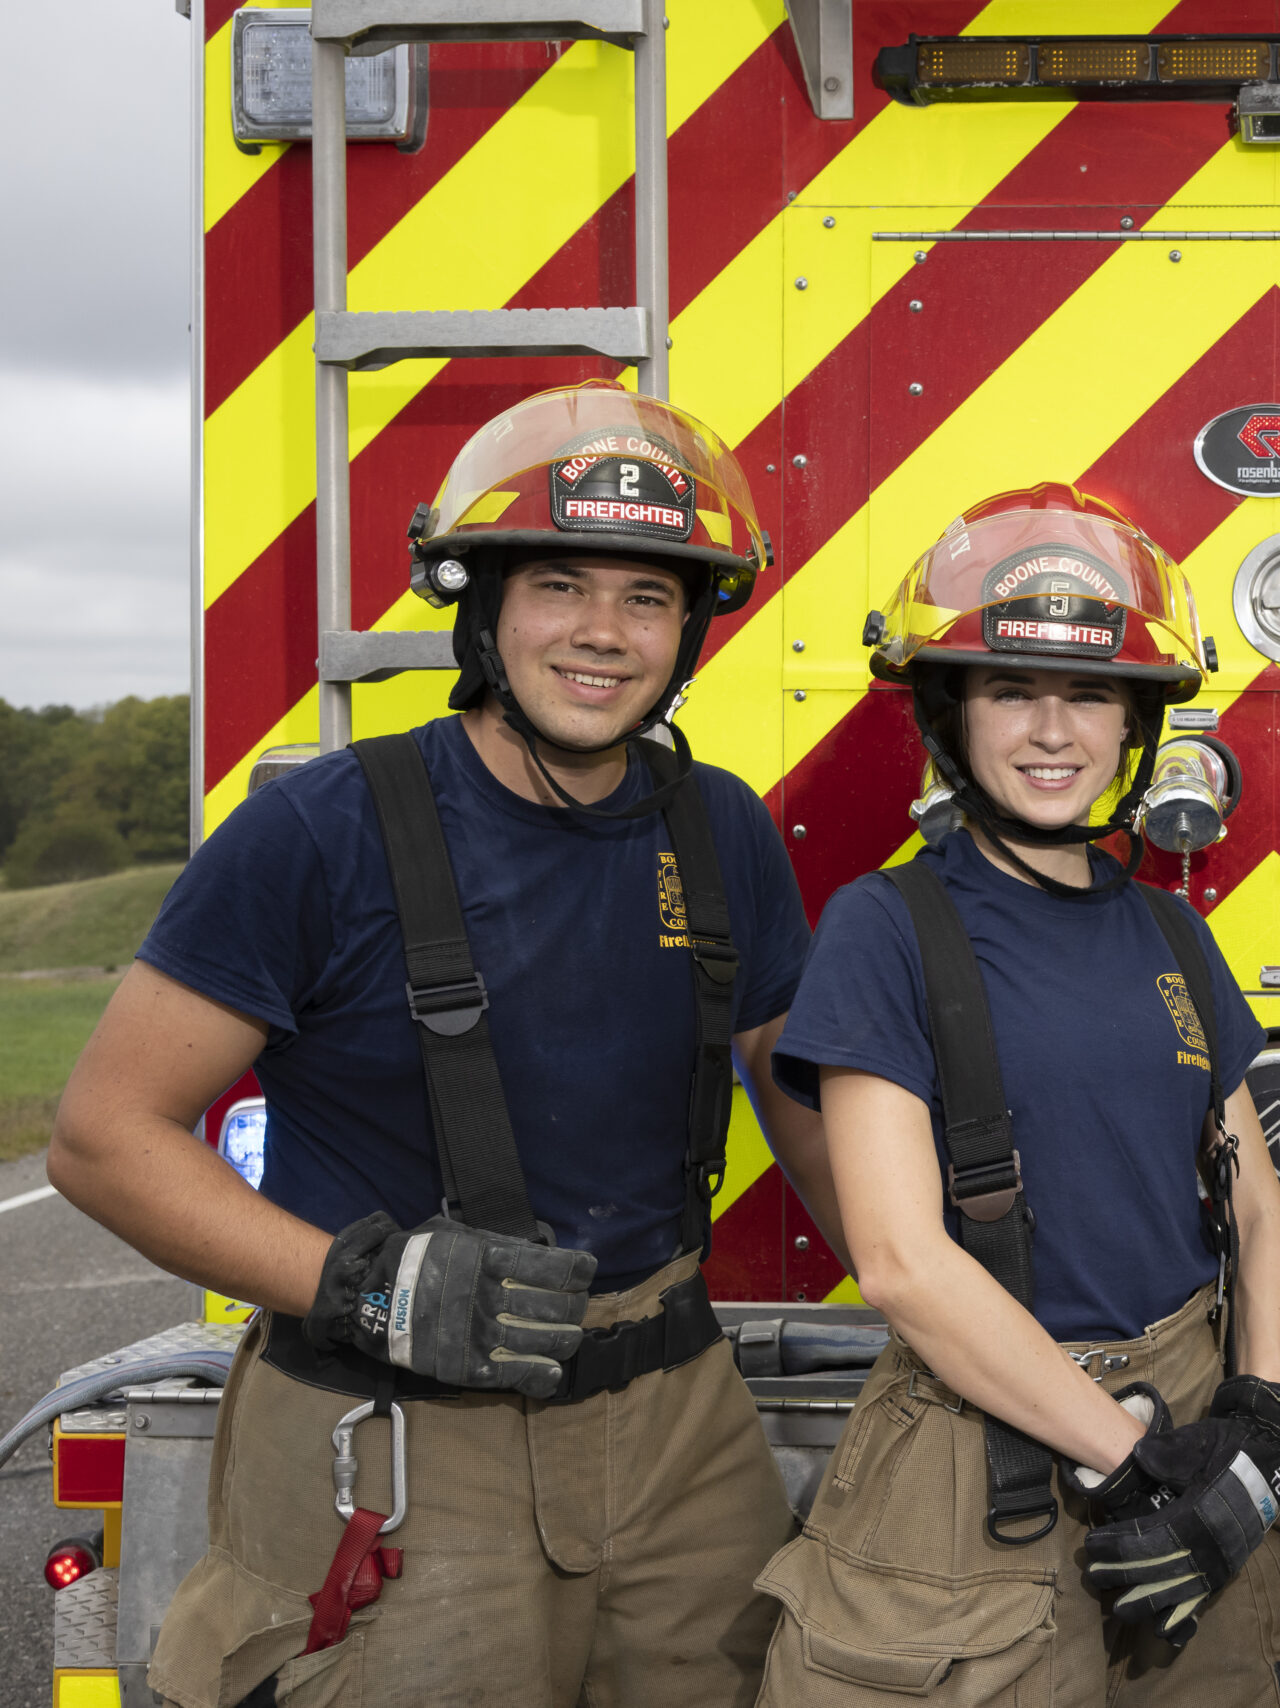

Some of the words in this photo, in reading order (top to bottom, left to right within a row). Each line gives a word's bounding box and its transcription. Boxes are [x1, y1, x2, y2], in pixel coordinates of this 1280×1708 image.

[562, 436, 620, 481] BOONE
[626, 436, 686, 492] COUNTY
[619, 463, 640, 497] 2
[566, 500, 684, 528] FIREFIGHTER
[995, 557, 1050, 598] BOONE
[1058, 557, 1121, 606] COUNTY
[1049, 581, 1070, 616] 5
[996, 620, 1114, 646] FIREFIGHTER
[395, 1289, 410, 1331] FUSION
